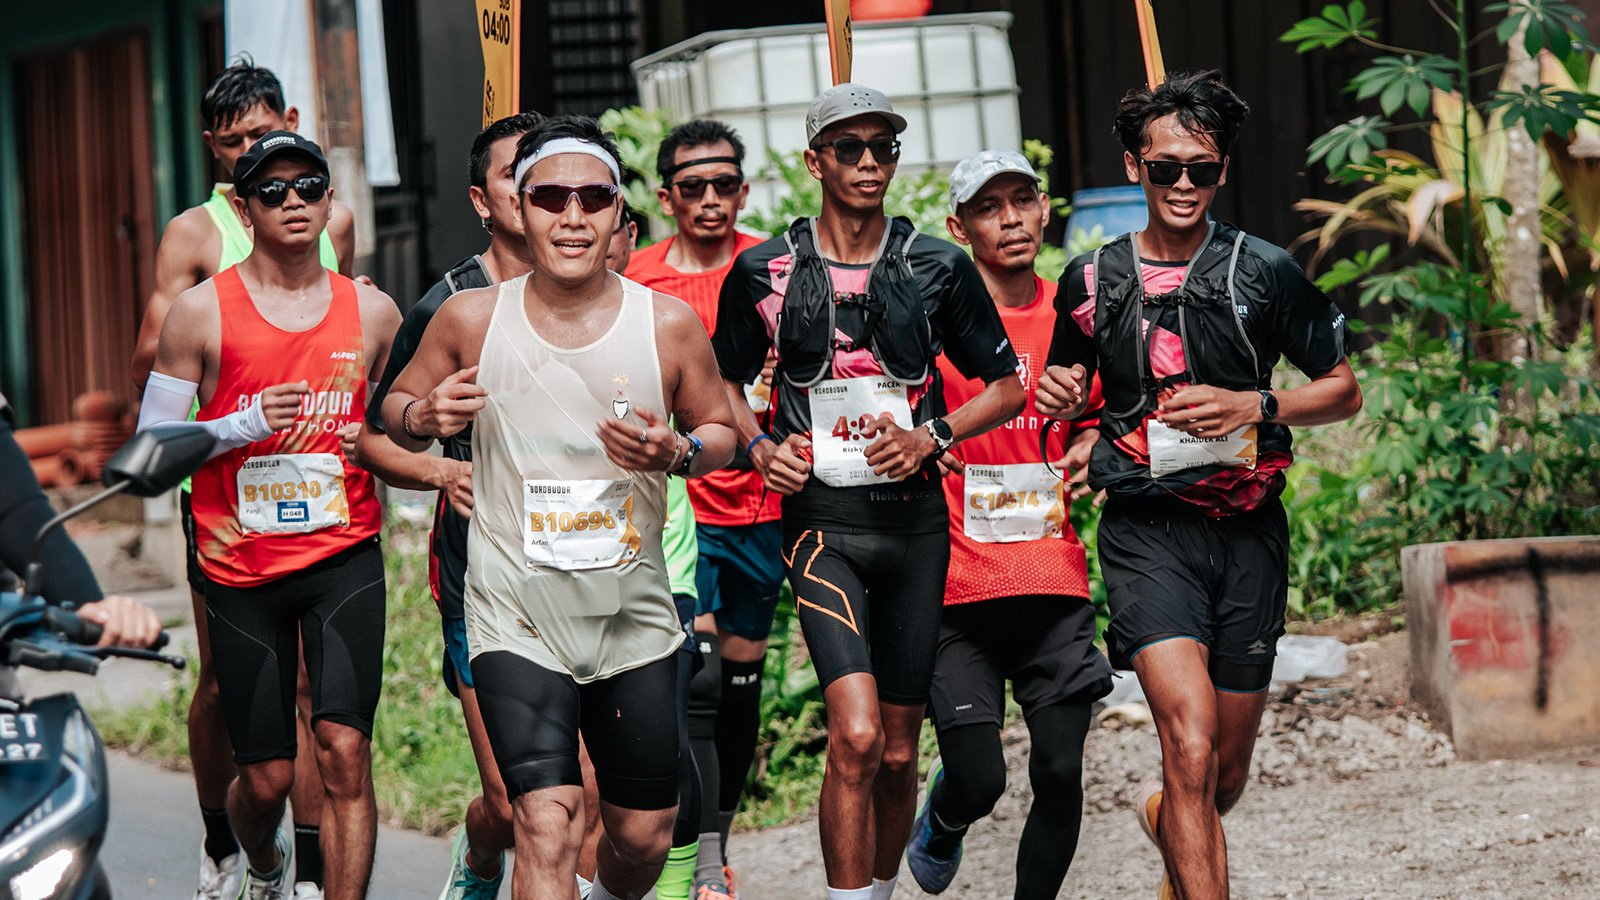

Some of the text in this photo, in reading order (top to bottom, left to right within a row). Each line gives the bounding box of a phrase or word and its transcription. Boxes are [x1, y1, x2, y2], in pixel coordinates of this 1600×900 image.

[483, 8, 510, 45] 04:00
[814, 386, 848, 395] BOROBUDUR
[243, 459, 280, 469] BOROBUDUR
[244, 480, 321, 502] B10310
[529, 485, 571, 494] BOROBUDUR
[969, 490, 1039, 511] C10574
[530, 509, 616, 533] B10696
[531, 539, 549, 547] Arfan
